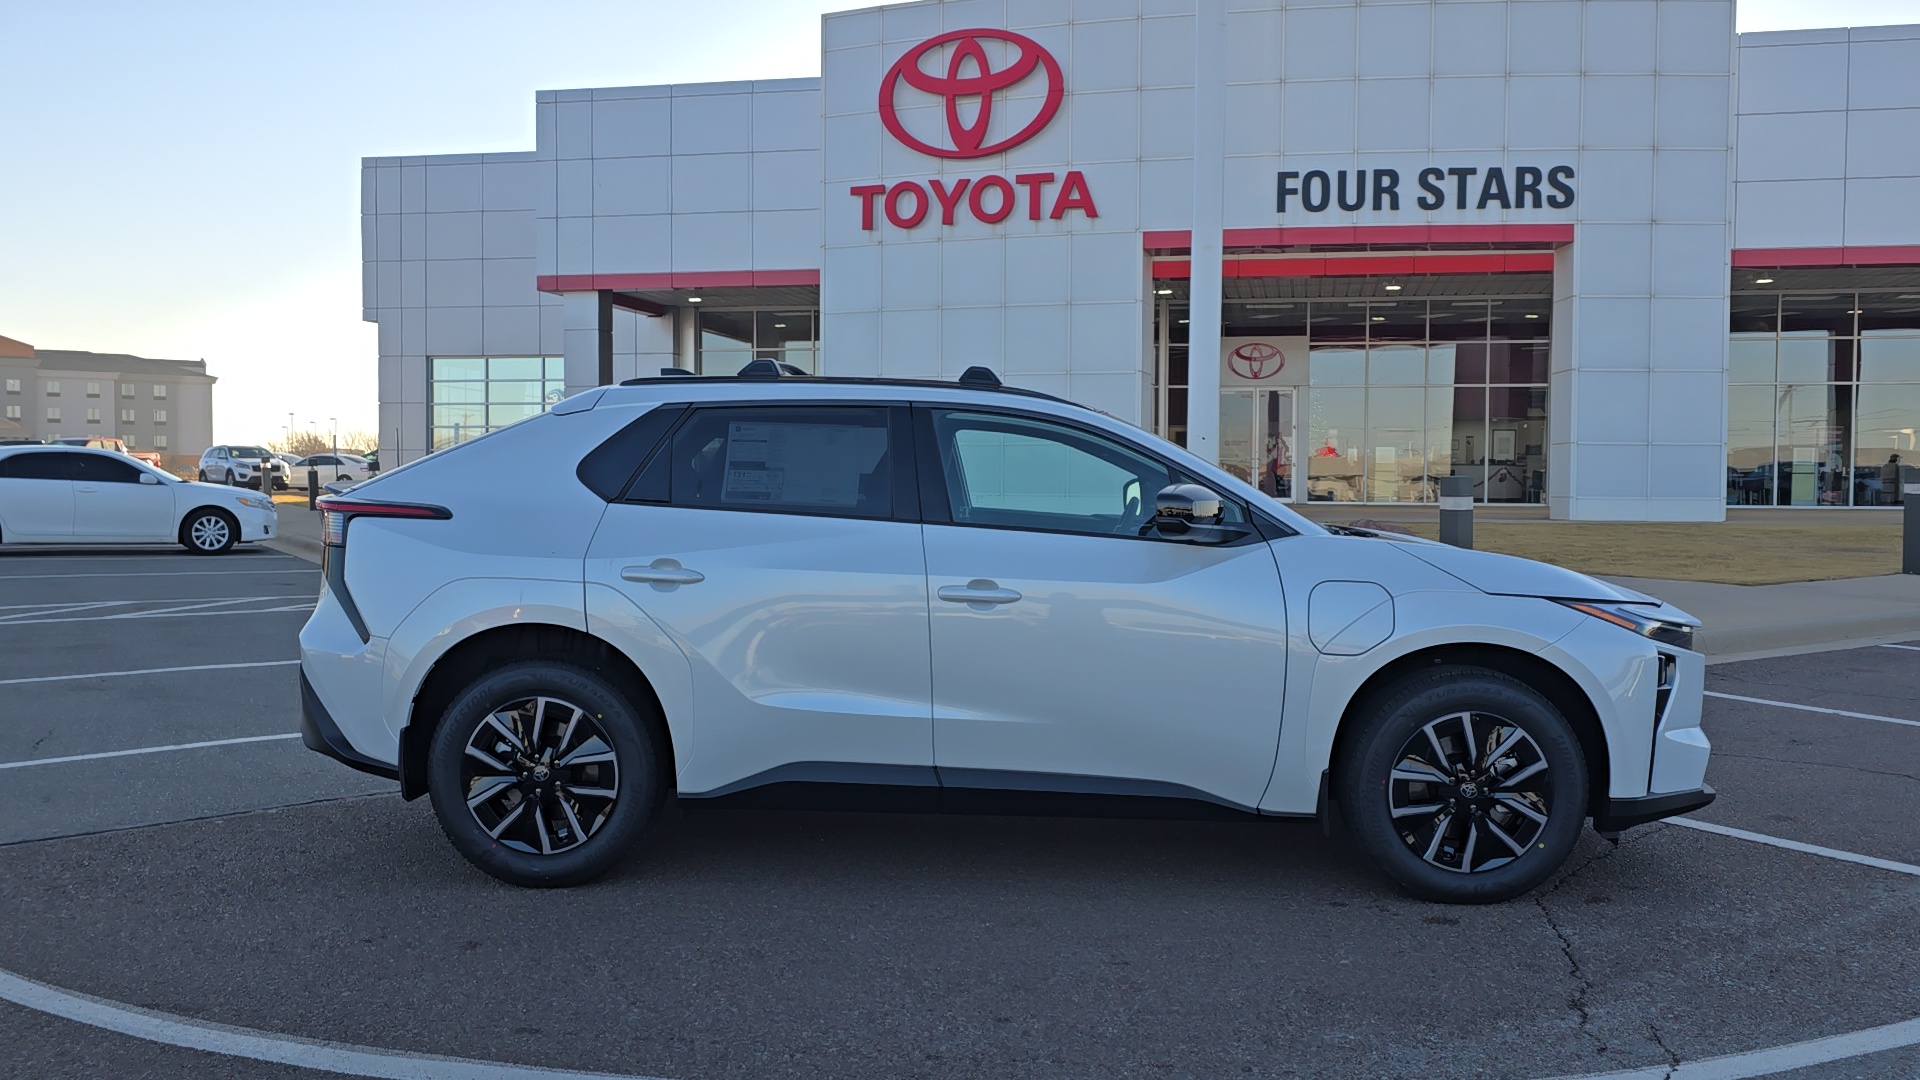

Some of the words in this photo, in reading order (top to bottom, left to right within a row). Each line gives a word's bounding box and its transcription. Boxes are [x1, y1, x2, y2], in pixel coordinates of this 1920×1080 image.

[850, 171, 1098, 230] TOYOTA
[1277, 169, 1399, 213] FOUR
[1417, 165, 1575, 210] STARS
[559, 674, 623, 719] TURANZA
[1425, 685, 1502, 702] TURANZA
[437, 682, 496, 769] BRIDGESTONE
